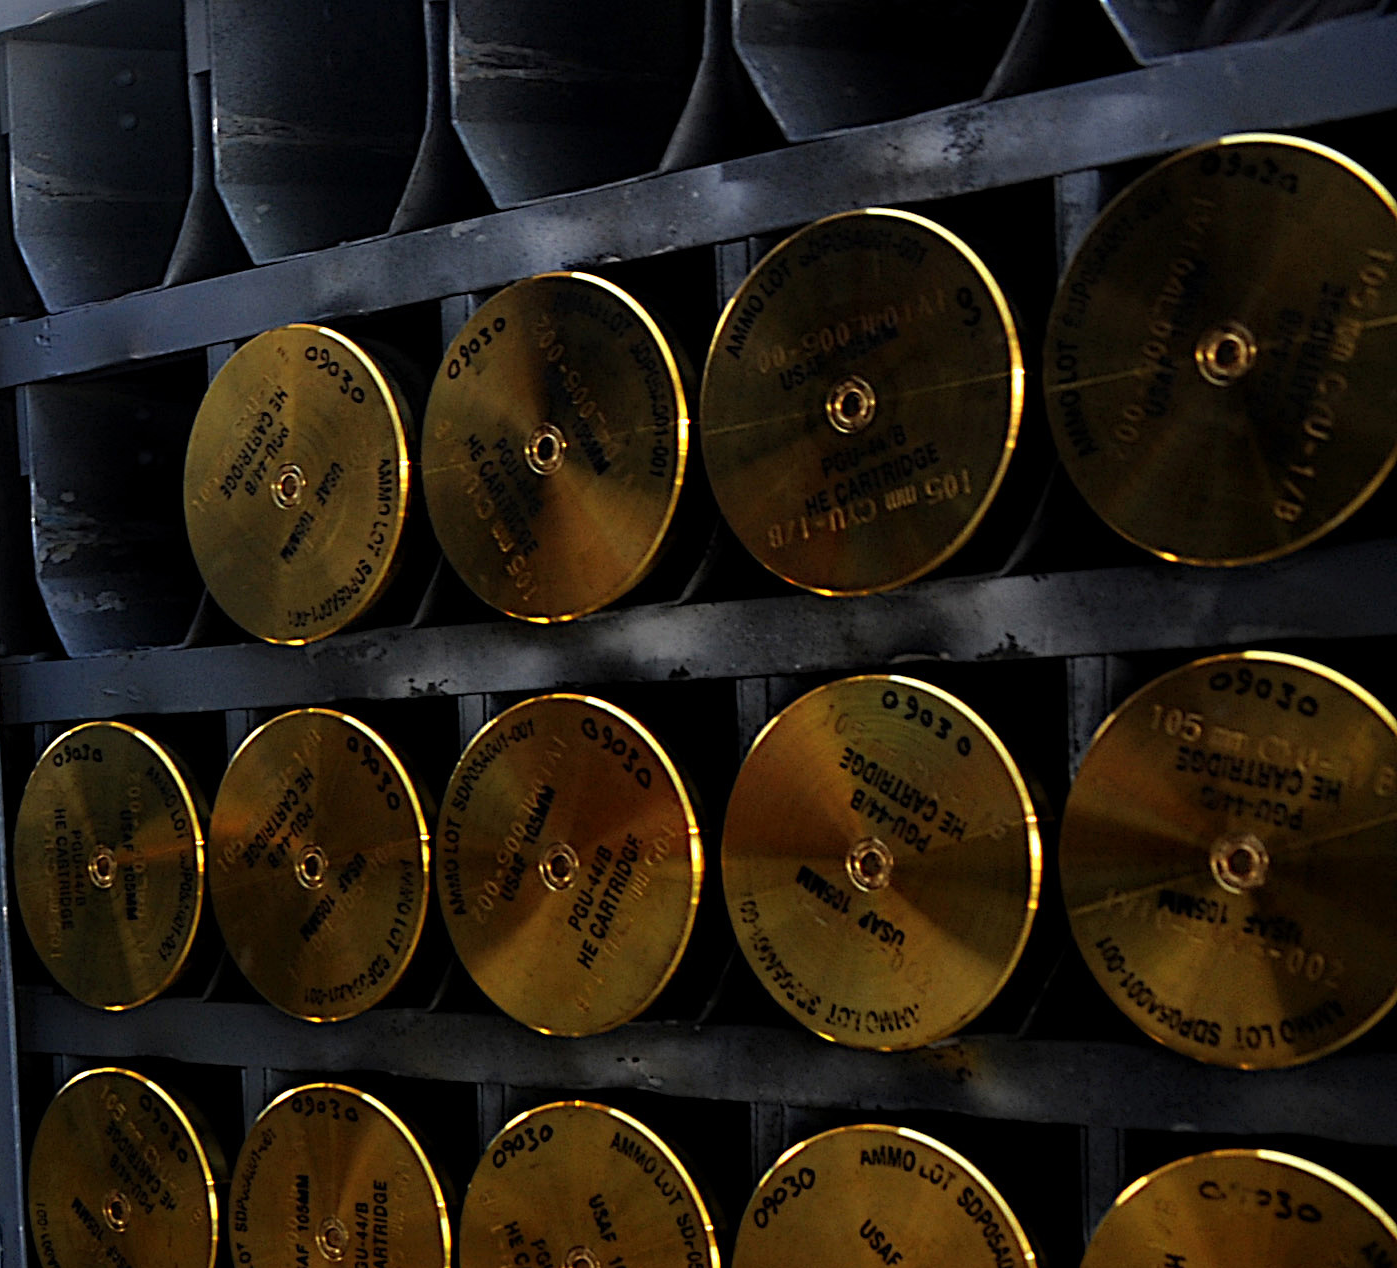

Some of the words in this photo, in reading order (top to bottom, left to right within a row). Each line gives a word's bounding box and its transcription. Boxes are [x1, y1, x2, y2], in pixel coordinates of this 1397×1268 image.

[725, 294, 764, 360] AMMO
[763, 258, 791, 298] LOT
[304, 346, 365, 404] 09030
[447, 317, 505, 380] 09030
[1057, 339, 1079, 377] LOT
[268, 386, 289, 413] HE
[220, 411, 274, 499] CARTRIDGE
[467, 434, 487, 462] HE
[317, 462, 344, 506] USAF
[377, 459, 393, 516] AMMO
[806, 488, 834, 517] HE
[833, 442, 941, 503] CARTRIDGE
[1208, 668, 1320, 718] 09030
[881, 689, 972, 757] 09030
[294, 767, 316, 794] HE
[346, 736, 401, 811] 09030
[580, 717, 653, 790] 09030
[1174, 745, 1304, 796] CARTRIDGE
[839, 746, 939, 822] CARTRIDGE
[1309, 774, 1344, 802] HE
[54, 808, 67, 829] HE
[245, 787, 301, 869] CARTRIDGE
[444, 816, 463, 855] LOT
[499, 857, 528, 902] USAF
[522, 784, 556, 845] 105MM
[850, 788, 933, 855] PGU-44/B
[937, 810, 968, 843] HE
[55, 834, 75, 931] CARTRIDGE
[443, 861, 467, 917] AMMO
[568, 844, 614, 932] PGU-44/B
[576, 939, 599, 970] HE
[589, 832, 645, 941] CARTRIDGE
[291, 1096, 359, 1122] 09030
[609, 1131, 656, 1175] AMMO
[860, 1145, 917, 1173] AMMO
[918, 1161, 958, 1192] LOT
[159, 1190, 177, 1212] HE
[297, 1173, 311, 1232] 105MM
[588, 1193, 618, 1244] USAF
[753, 1166, 817, 1231] 09030
[504, 1220, 525, 1249] HE
[858, 1218, 905, 1268] USAF
